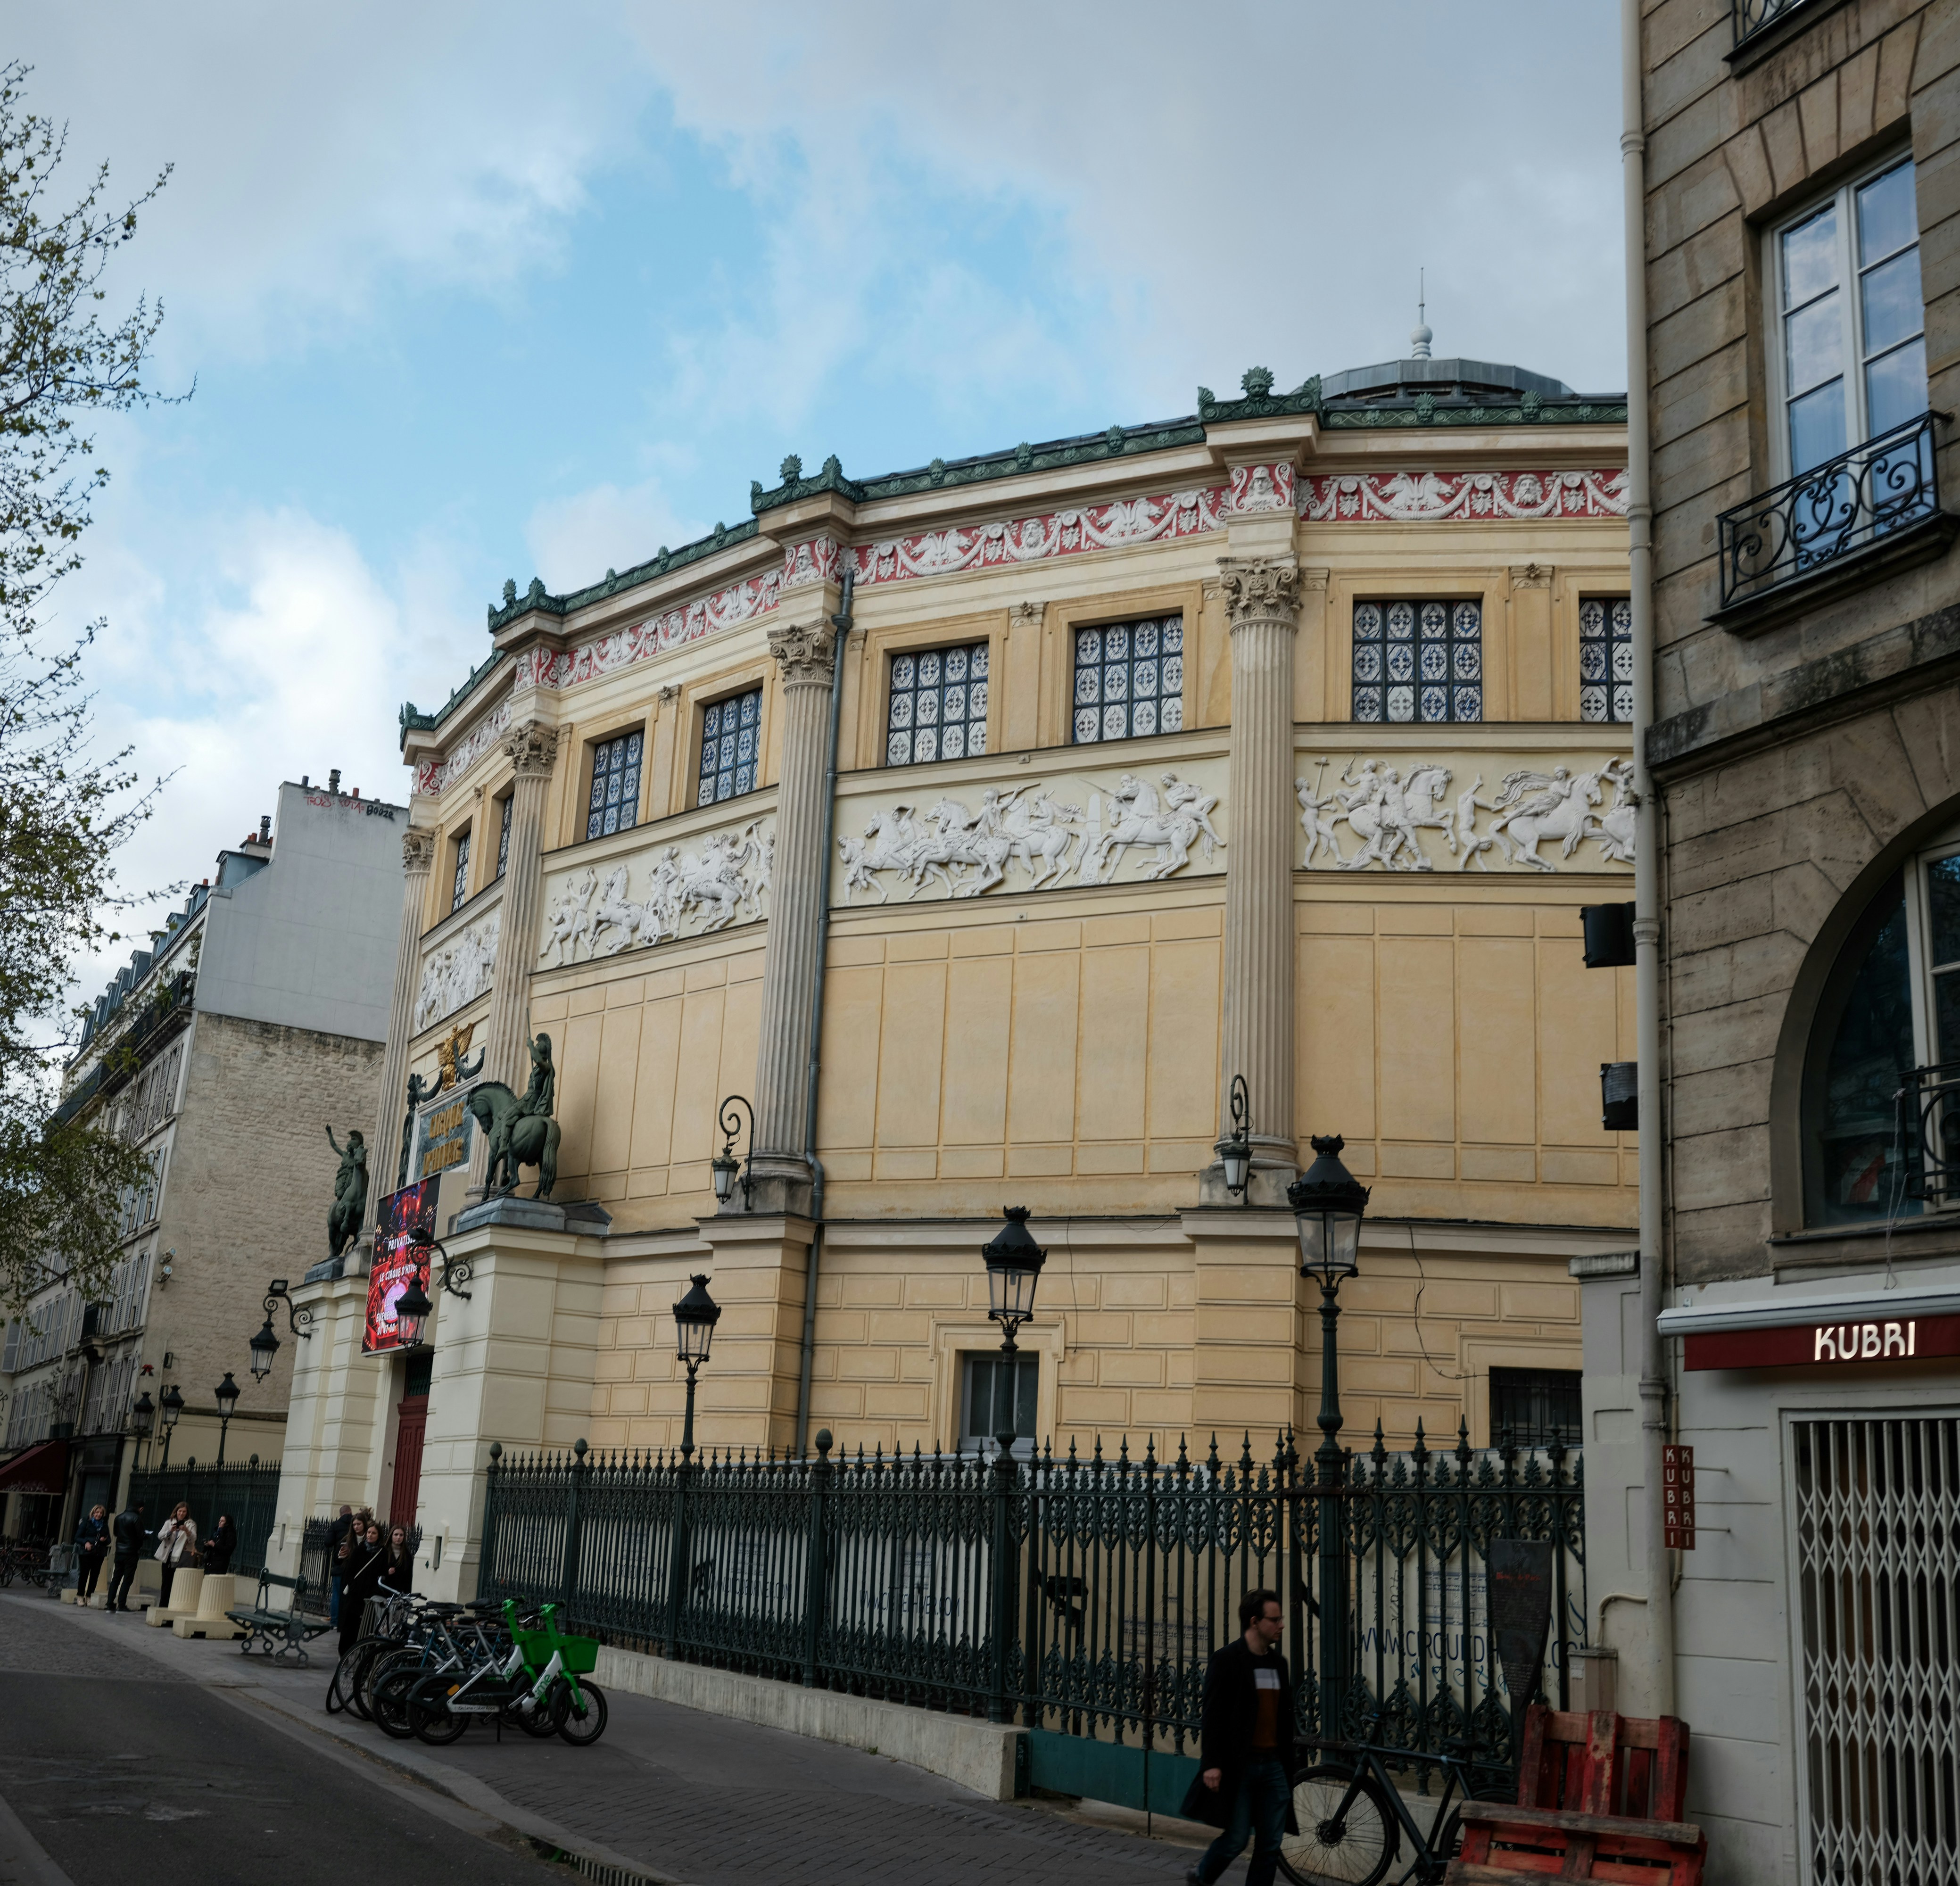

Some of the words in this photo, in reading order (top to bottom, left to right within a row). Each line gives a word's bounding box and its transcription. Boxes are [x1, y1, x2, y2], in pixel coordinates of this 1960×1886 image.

[430, 1101, 464, 1139] CIRQUE
[379, 1272, 385, 1282] LE
[385, 1267, 401, 1281] CIRQUE
[1815, 1322, 1916, 1361] KUBRI
[1666, 1448, 1676, 1546] KUBRI
[1681, 1449, 1692, 1547] KUBRI
